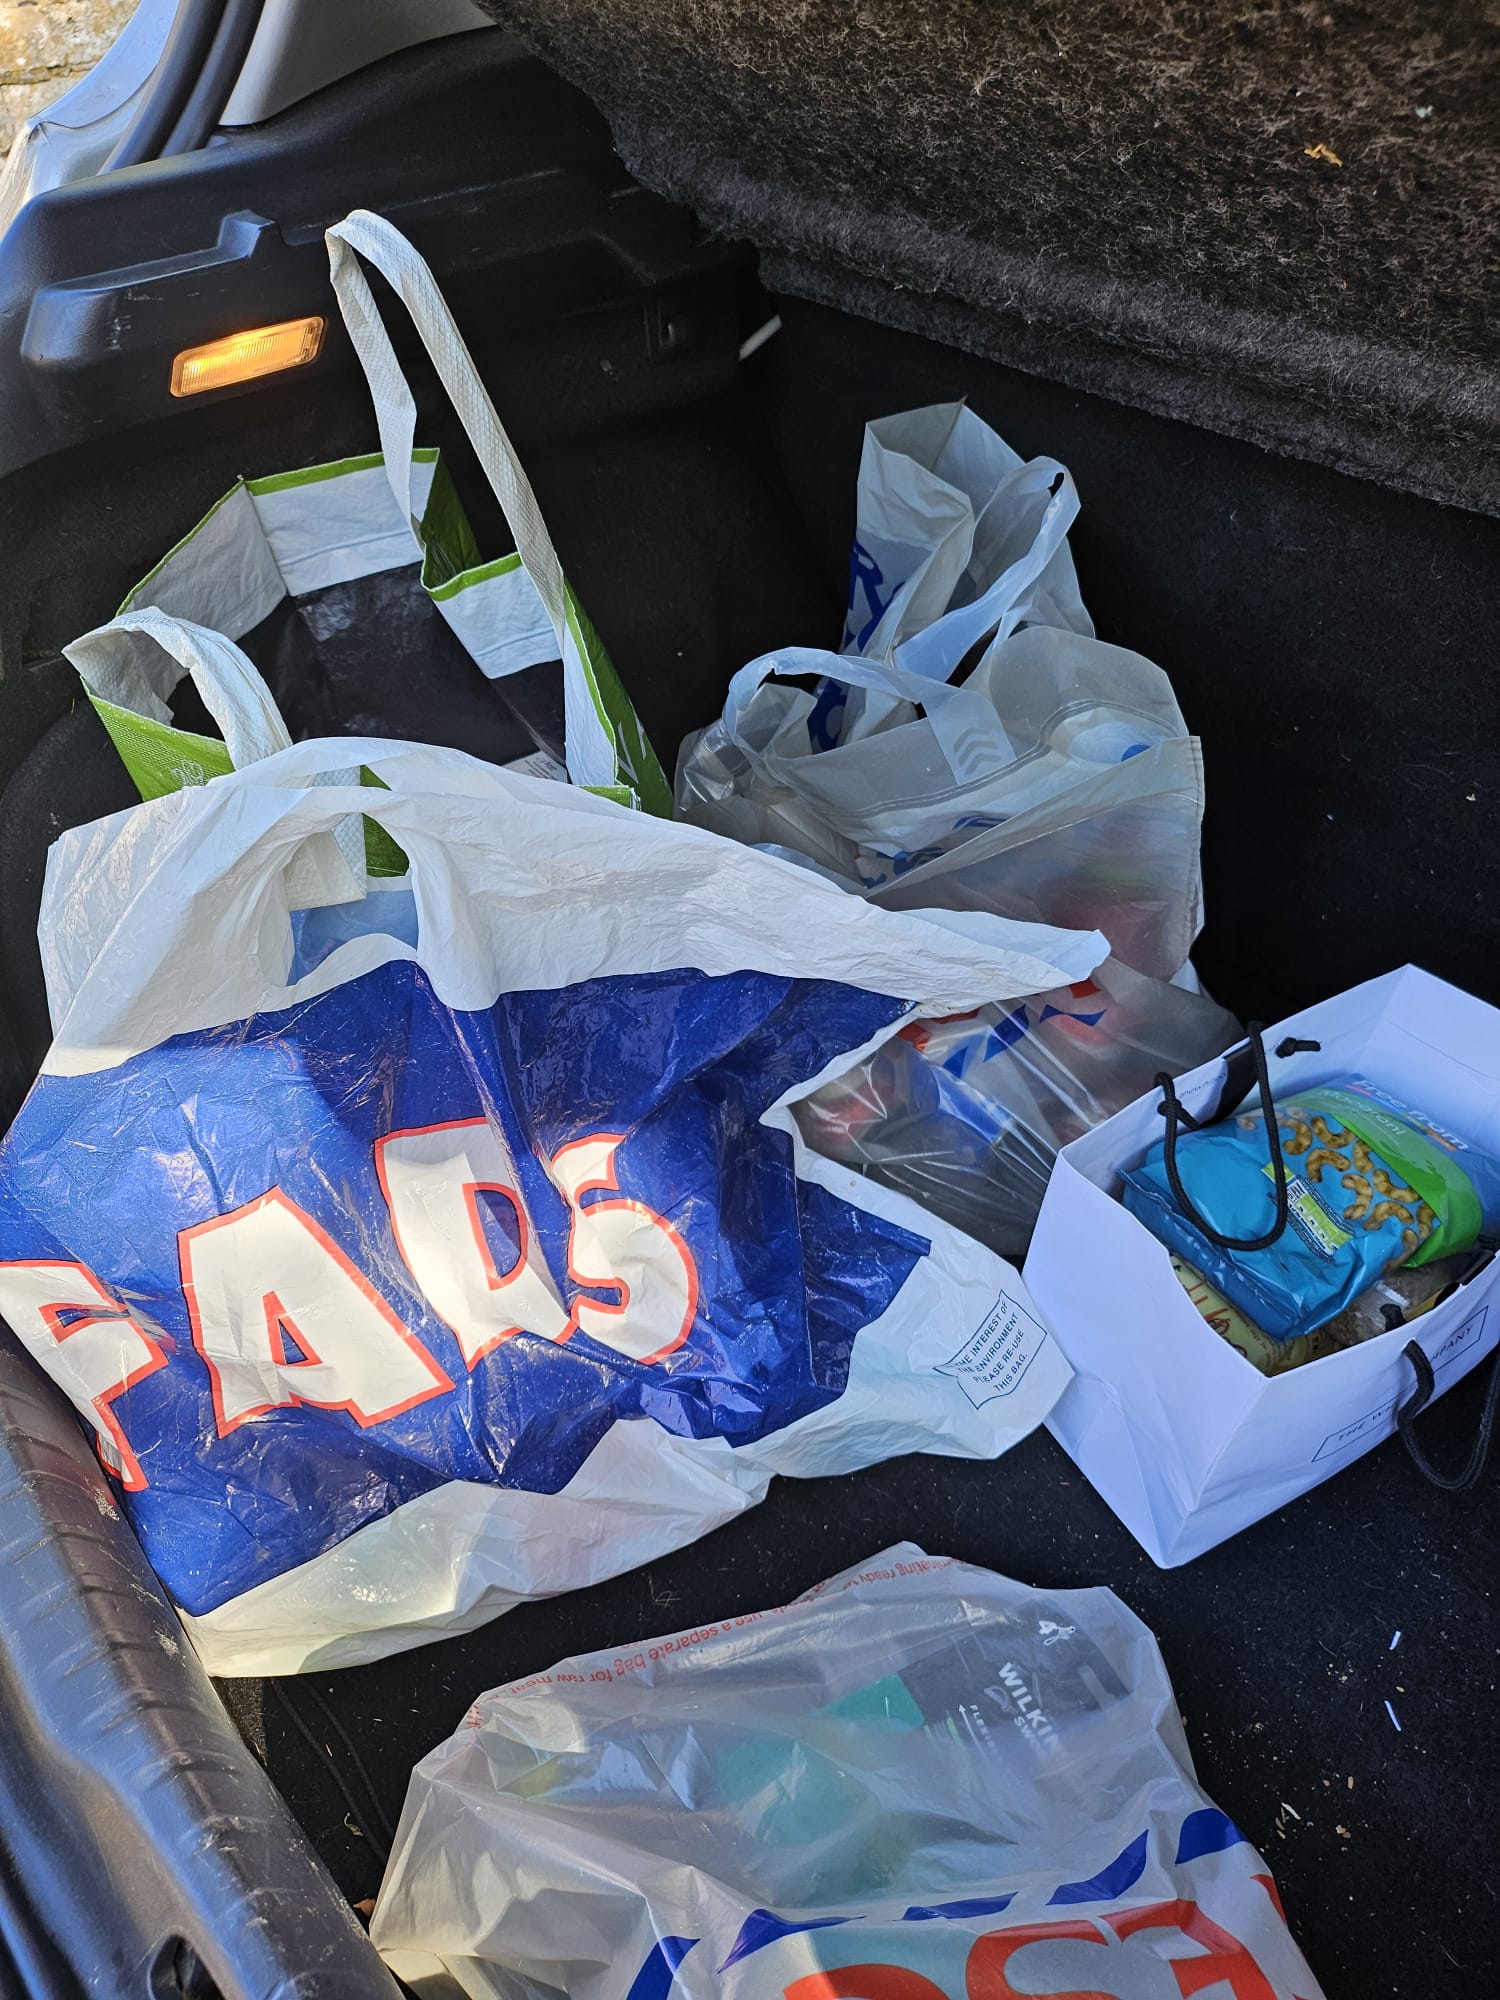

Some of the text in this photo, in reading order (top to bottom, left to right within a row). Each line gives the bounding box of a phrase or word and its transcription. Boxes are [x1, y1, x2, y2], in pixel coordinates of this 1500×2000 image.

[1350, 1079, 1469, 1150] Free from
[958, 1311, 1018, 1374] THE ENVIRONMENT
[969, 1312, 1003, 1357] INTEREST
[1000, 1301, 1008, 1314] OF
[972, 1329, 1024, 1384] PLEASE RE-USE
[993, 1353, 1028, 1392] THIS BAG.
[858, 1570, 896, 1584] ready
[720, 1622, 732, 1632] a
[735, 1611, 763, 1627] use
[647, 1626, 719, 1661] separate
[556, 1673, 585, 1683] raw
[589, 1668, 614, 1682] for
[612, 1653, 647, 1677] bag
